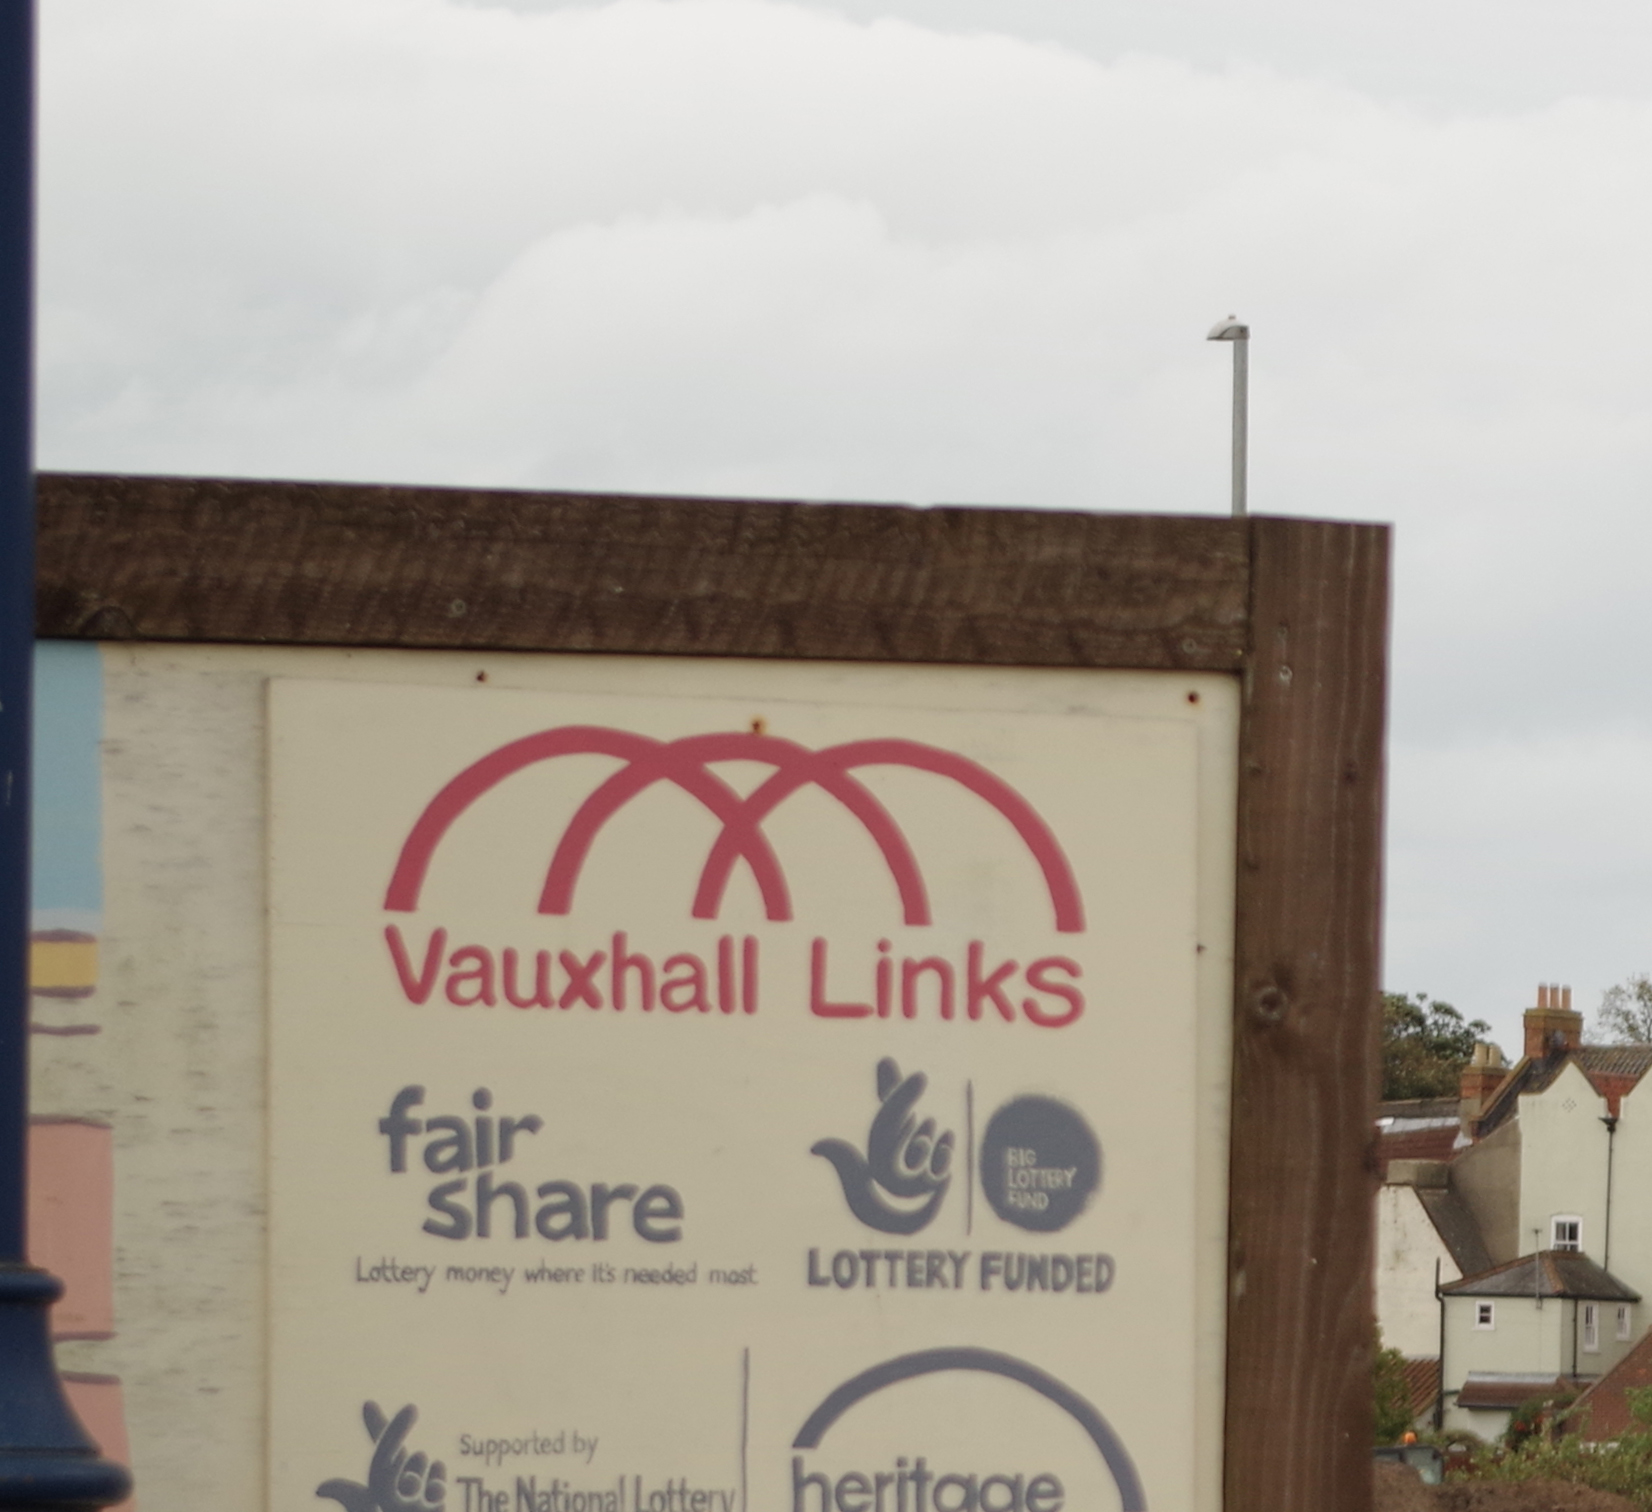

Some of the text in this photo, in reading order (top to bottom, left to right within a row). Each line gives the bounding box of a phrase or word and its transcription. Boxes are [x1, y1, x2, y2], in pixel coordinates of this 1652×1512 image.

[384, 923, 1087, 1030] Vauxhall Links
[378, 1083, 545, 1174] fair
[1006, 1147, 1037, 1167] BIG
[1007, 1166, 1078, 1190] LOTTERY
[421, 1169, 685, 1243] share
[1007, 1190, 1050, 1211] FUND
[355, 1256, 435, 1294] Lottery
[445, 1265, 516, 1294] money
[524, 1263, 585, 1284] where
[623, 1262, 698, 1286] needed
[708, 1263, 758, 1286] most
[806, 1246, 1117, 1294] LOTTERY FUNDED
[459, 1429, 600, 1467] Supported by
